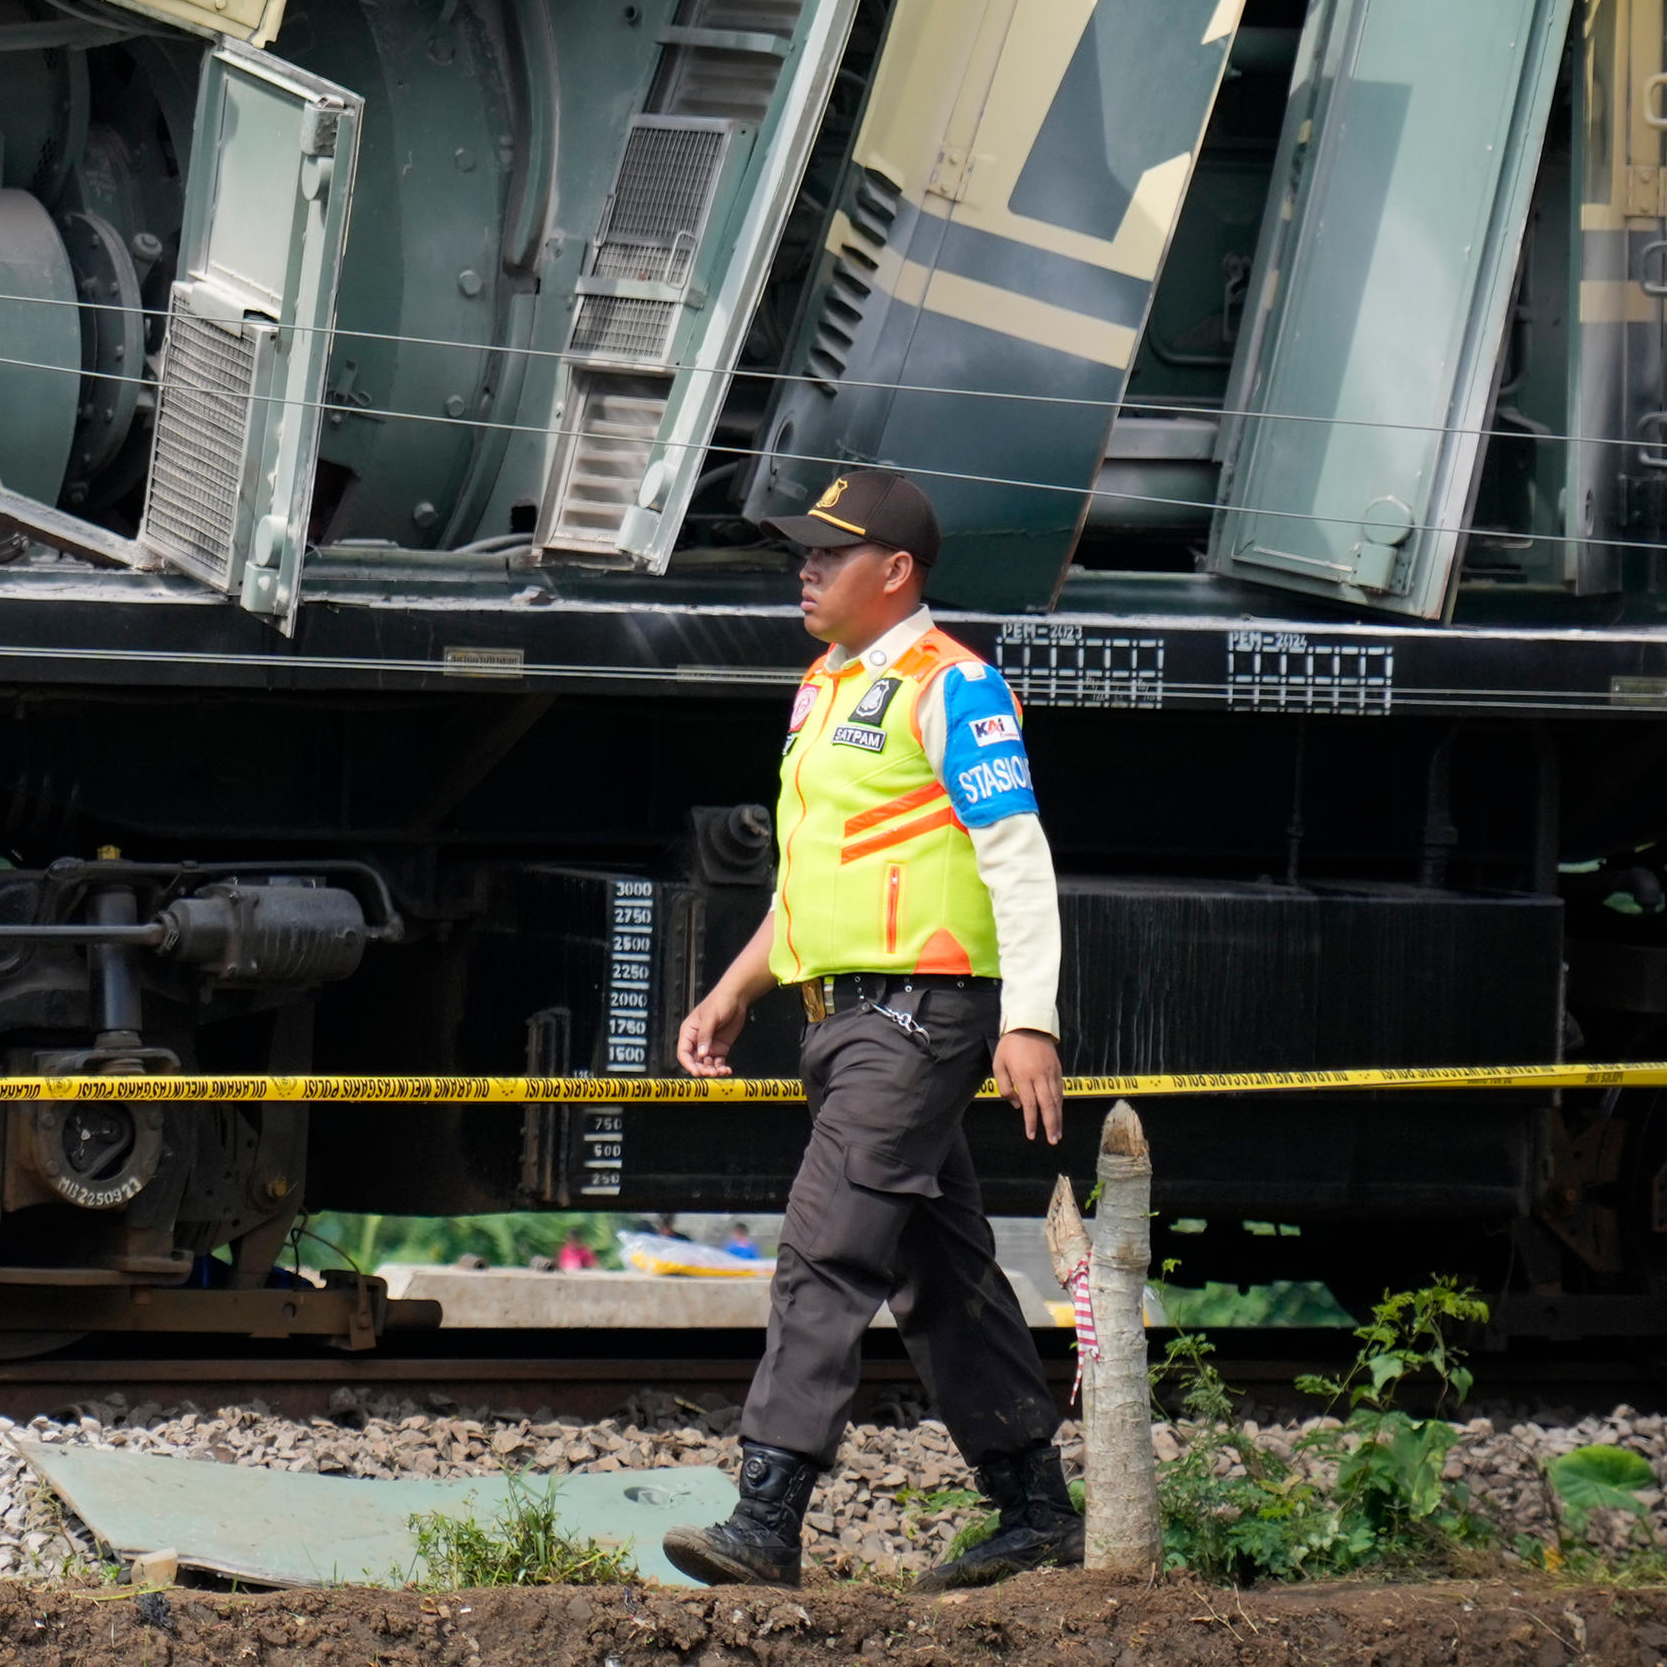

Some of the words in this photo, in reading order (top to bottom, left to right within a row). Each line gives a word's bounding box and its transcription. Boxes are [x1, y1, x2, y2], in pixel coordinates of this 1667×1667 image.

[835, 727, 881, 749] SATPAM
[616, 882, 652, 897] 3000
[615, 909, 651, 924] 2750
[613, 936, 650, 951] 2500
[612, 965, 649, 980] 2250
[610, 992, 648, 1007] 2000
[609, 1019, 646, 1035] 1750
[608, 1047, 645, 1062] 1500
[77, 1082, 114, 1098] POLISI
[211, 1080, 267, 1098] DILARANG
[301, 1079, 339, 1098] POLISI
[435, 1078, 490, 1098] DILARANG
[525, 1078, 561, 1098] POLISI
[655, 1079, 709, 1097] DILARANG
[744, 1079, 779, 1097] POLISI
